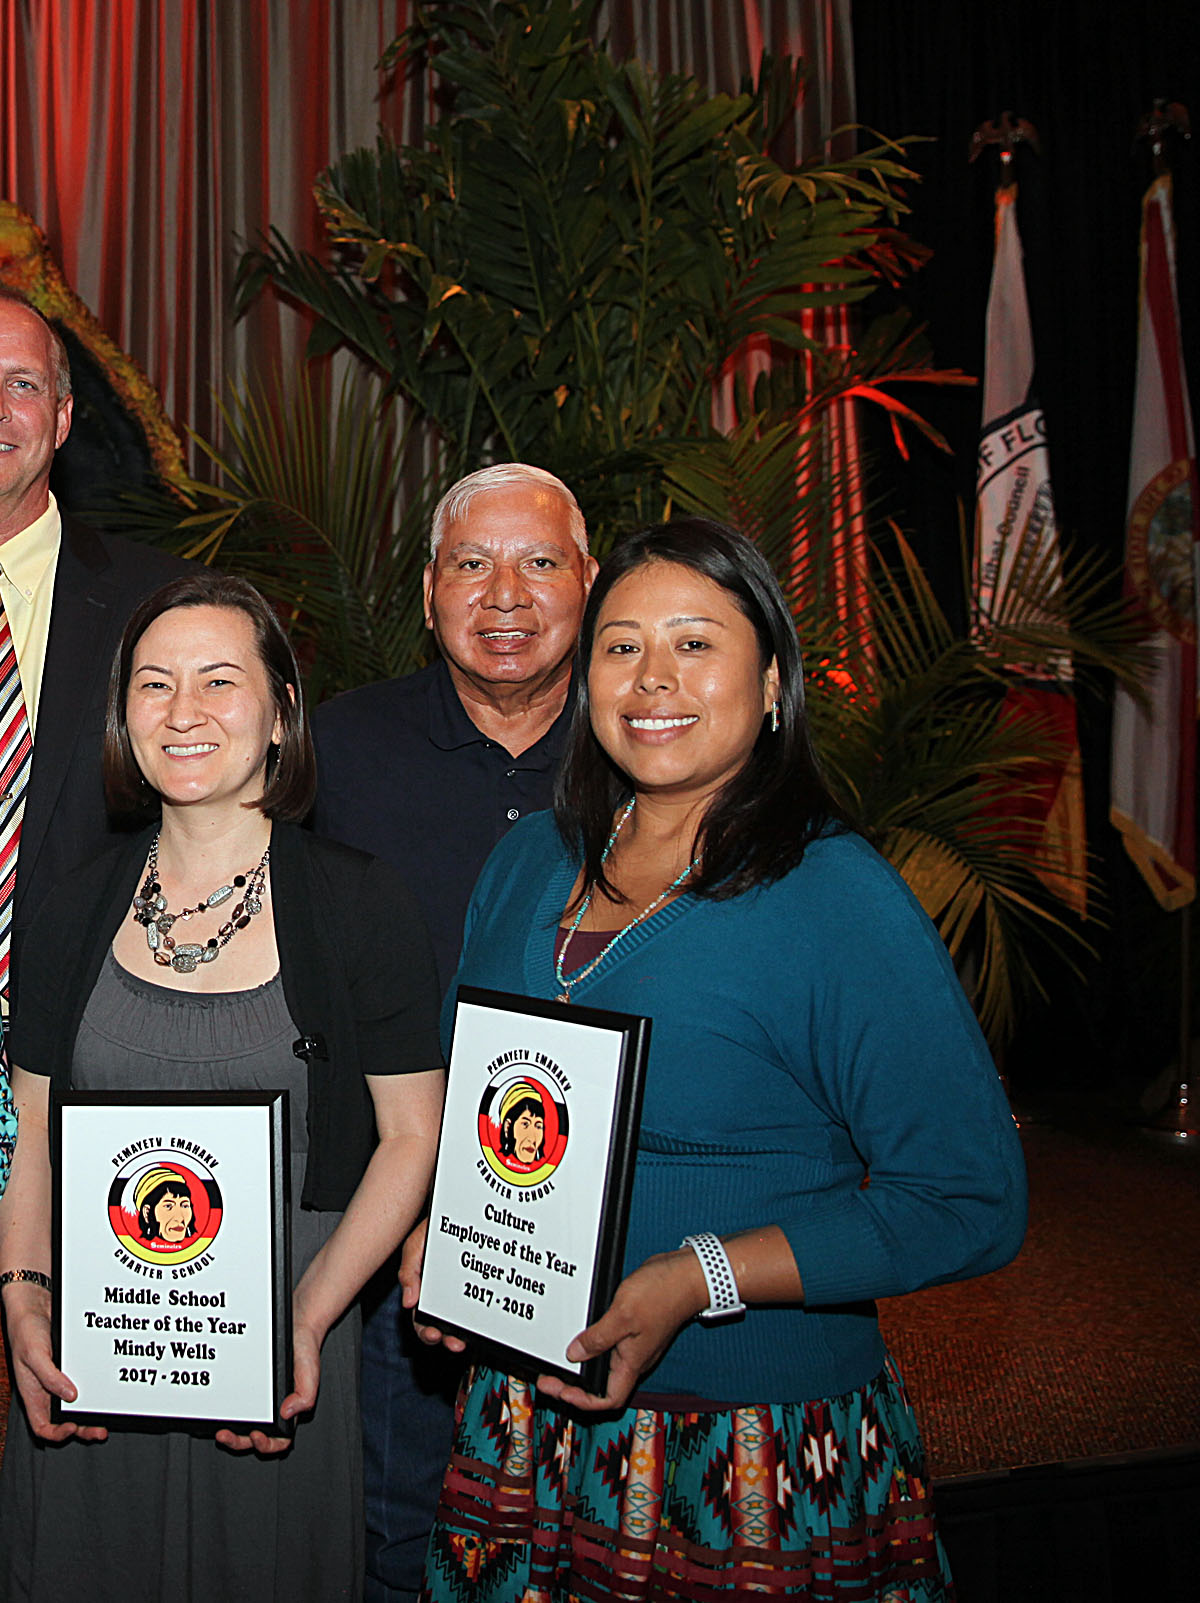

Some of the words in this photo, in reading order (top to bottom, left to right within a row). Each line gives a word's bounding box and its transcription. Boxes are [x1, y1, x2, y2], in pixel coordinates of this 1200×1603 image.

[487, 1049, 530, 1075] PEMAYETV
[112, 1137, 162, 1168] PEMAYETV
[171, 1137, 219, 1168] EMAHAKV
[477, 1159, 512, 1200] CHARTER
[518, 1182, 555, 1202] SCHOOL
[484, 1203, 535, 1234] Culture
[440, 1217, 500, 1251] Employee
[503, 1240, 517, 1258] of
[520, 1245, 542, 1265] the
[546, 1251, 577, 1277] Year
[114, 1249, 163, 1280] CHARTER
[172, 1252, 216, 1280] SCHOOL
[461, 1251, 504, 1282] Ginger
[507, 1267, 545, 1296] Jones
[104, 1287, 160, 1305] Middle
[168, 1290, 225, 1308] School
[464, 1282, 493, 1308] 2017
[502, 1296, 534, 1320] 2018
[84, 1312, 149, 1330] Teacher
[154, 1316, 171, 1332] of
[175, 1317, 203, 1333] the
[207, 1317, 246, 1335] Year
[114, 1340, 165, 1361] Mindy
[171, 1342, 216, 1359] Wells
[119, 1368, 157, 1386] 2017
[171, 1370, 210, 1386] 2018
